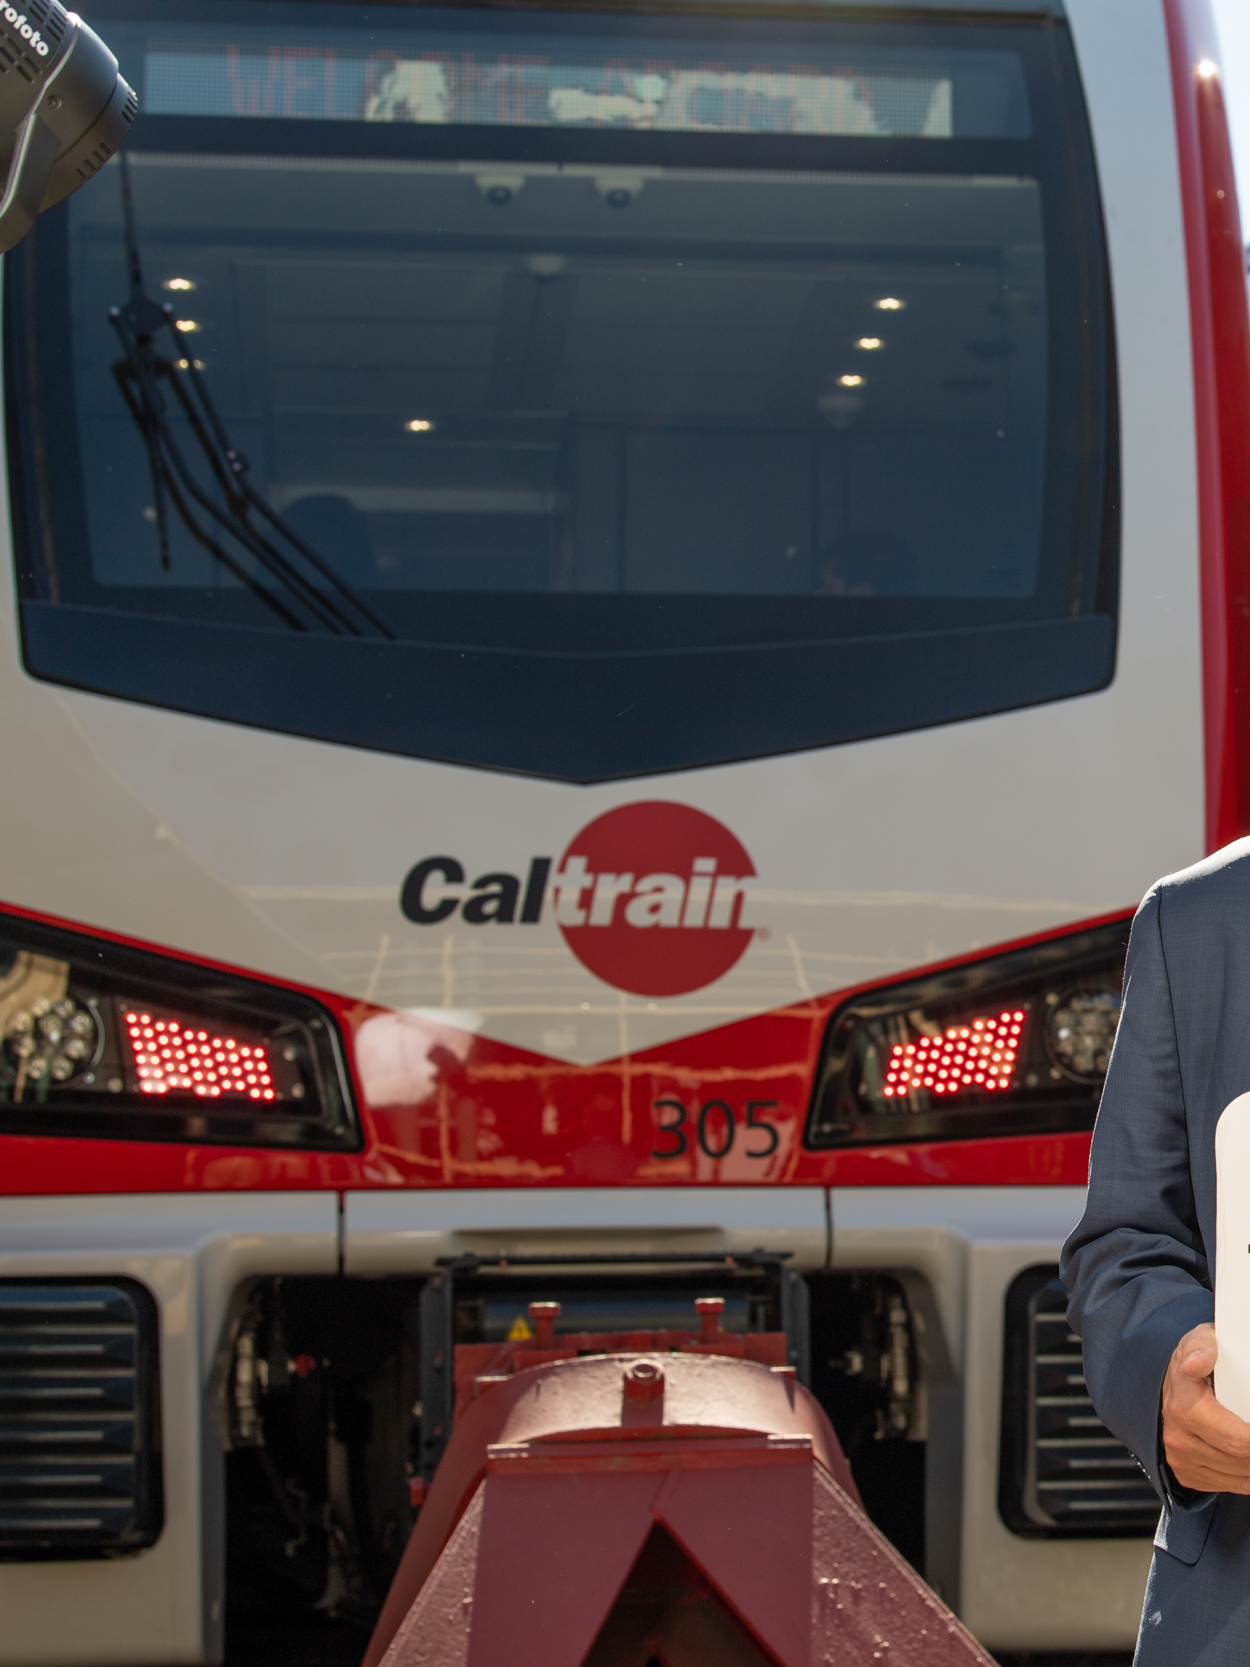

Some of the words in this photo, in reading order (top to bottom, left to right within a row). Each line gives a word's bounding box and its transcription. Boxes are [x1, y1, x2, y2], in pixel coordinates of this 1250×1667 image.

[226, 44, 549, 125] WELCOME
[399, 855, 759, 929] Caltrain
[651, 1099, 780, 1159] 305
